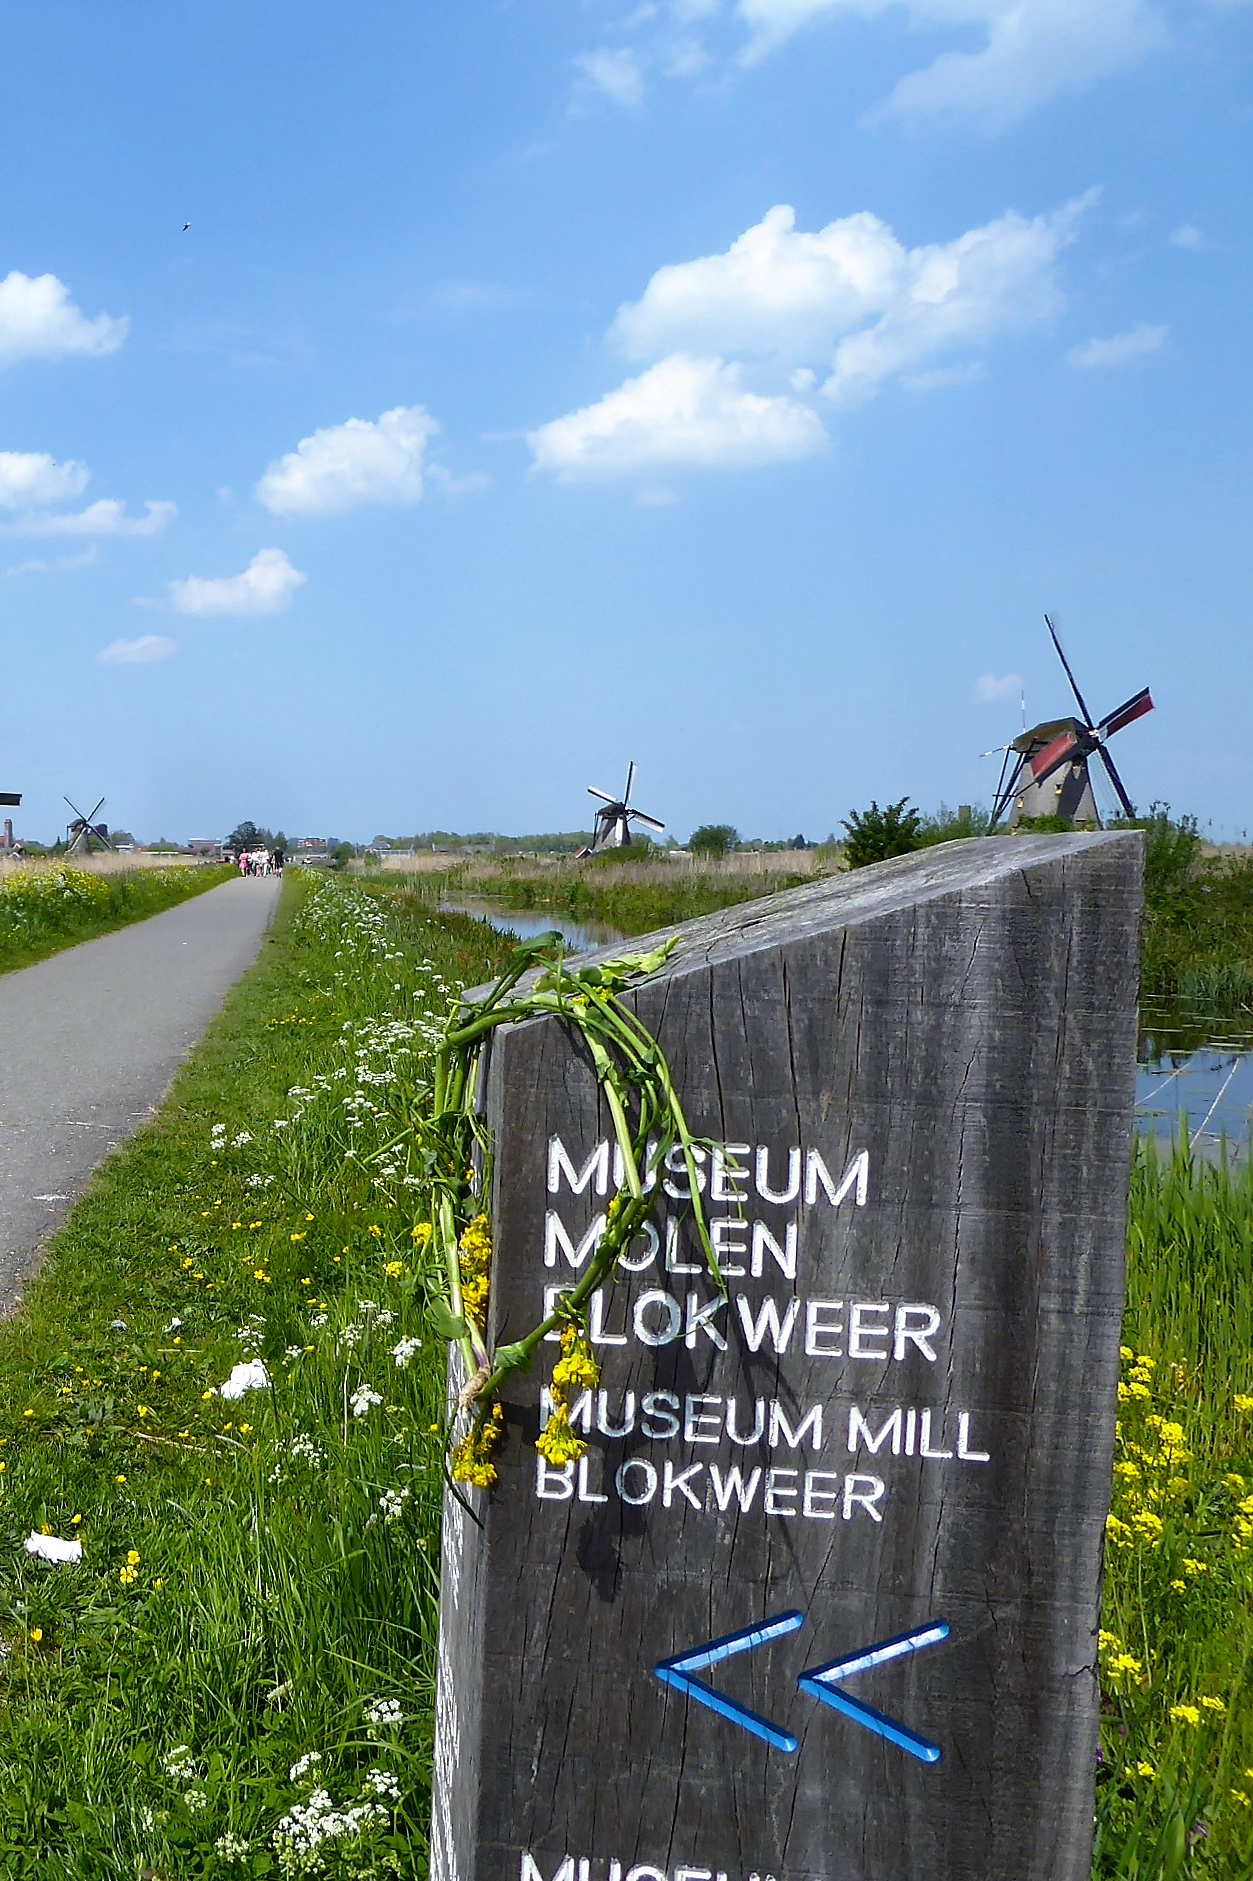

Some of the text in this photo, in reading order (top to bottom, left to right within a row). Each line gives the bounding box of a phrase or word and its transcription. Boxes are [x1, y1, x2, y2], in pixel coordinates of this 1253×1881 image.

[547, 1133, 869, 1206] MUSEUM
[544, 1208, 797, 1280] MOLEN
[539, 1384, 991, 1462] MUSEUM MILL
[535, 1453, 886, 1523] BLOKWEER
